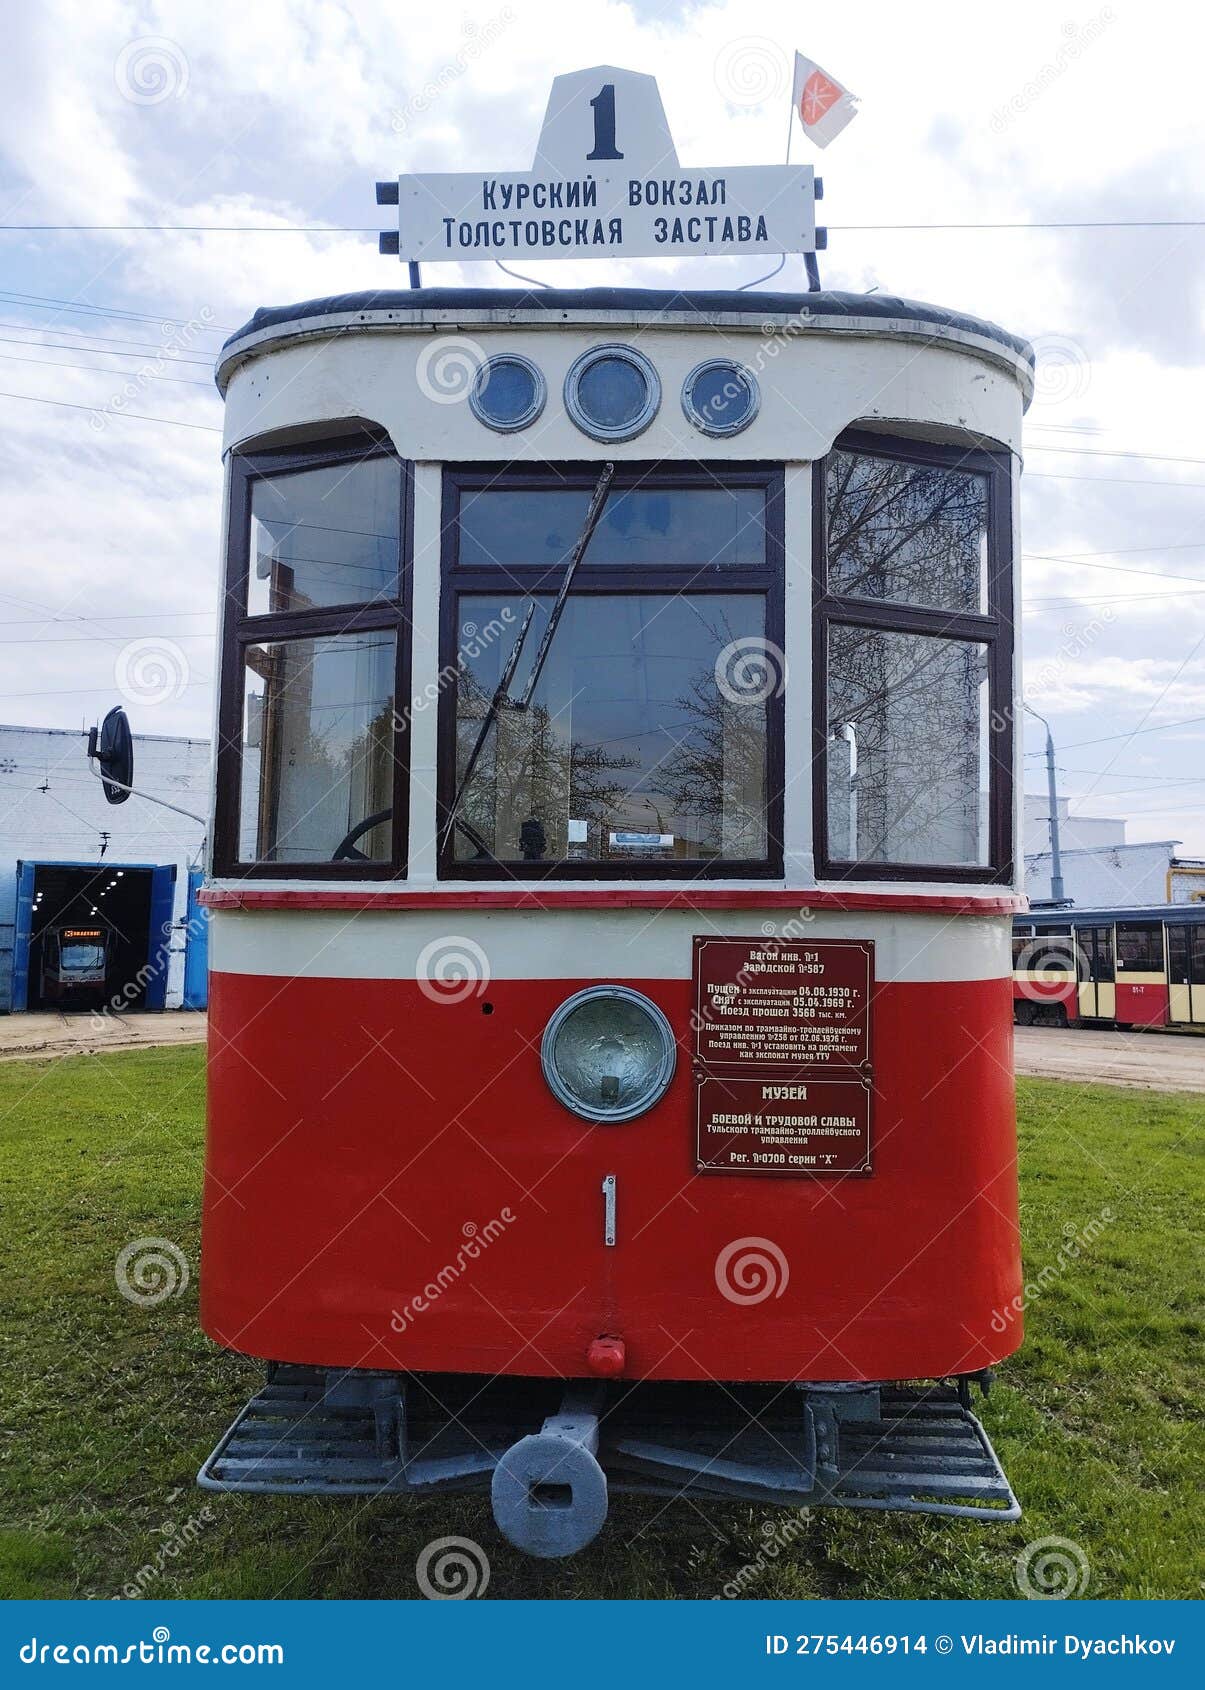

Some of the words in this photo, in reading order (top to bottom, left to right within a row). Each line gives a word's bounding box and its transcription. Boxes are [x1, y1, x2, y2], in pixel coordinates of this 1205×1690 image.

[586, 84, 624, 161] 1
[628, 179, 726, 207] ВОКЗАЛ
[443, 217, 622, 248] ТОЛСТОВСКАЯ
[654, 215, 768, 244] ЗАСТАВА
[750, 951, 778, 961] Вагон
[781, 952, 801, 961] инв.
[743, 962, 795, 973] Заводской
[853, 989, 861, 998] г.
[793, 997, 844, 1008] 05.04.1969
[847, 1000, 855, 1008] г.
[720, 1005, 750, 1016] Поезд
[752, 1007, 789, 1017] прошел
[792, 1007, 816, 1018] 3568
[705, 1023, 743, 1031] Приказом
[719, 1032, 766, 1040] управлению
[708, 1040, 731, 1048] Поезд
[763, 1042, 806, 1051] установить
[819, 1044, 858, 1052] постамент
[755, 1051, 789, 1059] экспонат
[762, 1086, 807, 1100] МУЗЕЙ
[712, 1113, 752, 1125] БОЕВОЙ
[754, 1115, 763, 1125] И
[765, 1115, 818, 1127] ТРУДОВОЙ
[820, 1116, 856, 1127] СЛАВЫ
[707, 1124, 749, 1134] Тульского
[751, 1126, 861, 1136] трамвайно-троллейбусного
[761, 1136, 808, 1144] управления
[730, 1152, 750, 1162] Рег.
[788, 1154, 816, 1165] серии
[602, 1175, 616, 1246] 1
